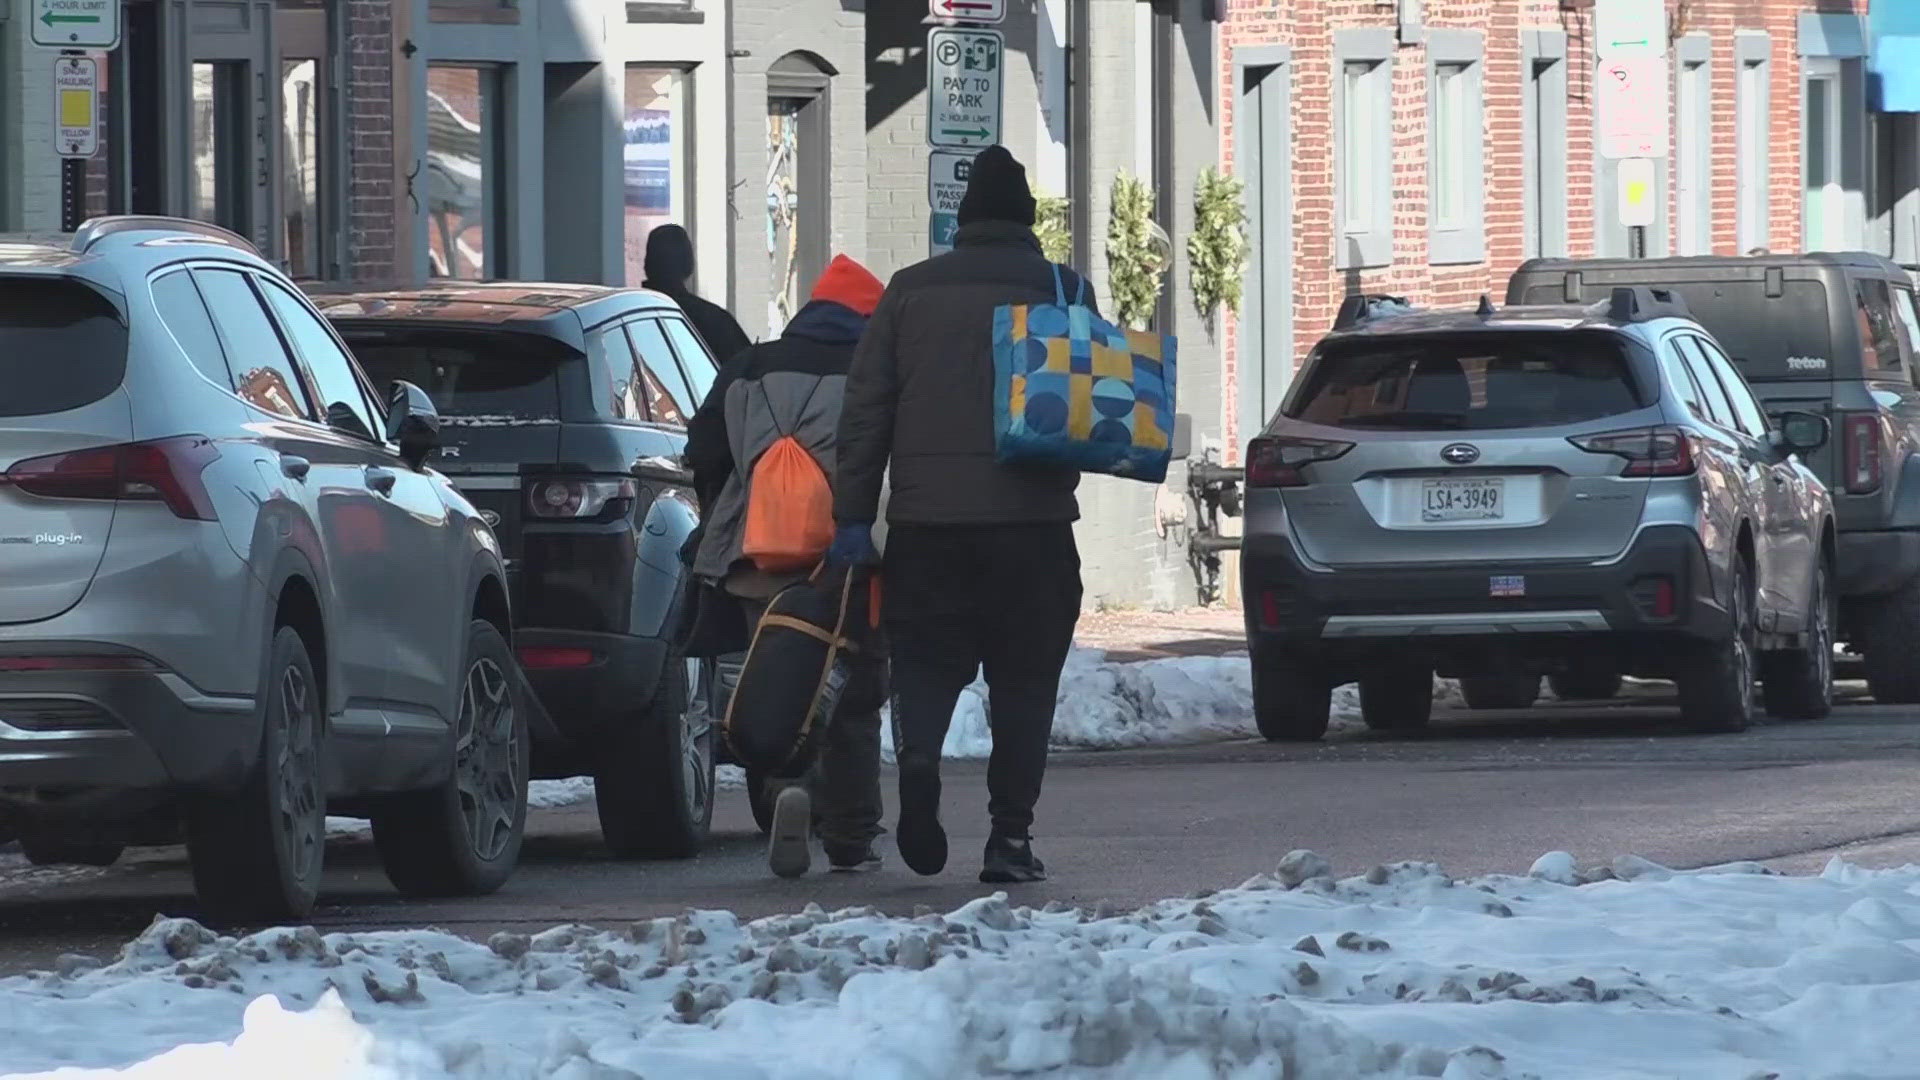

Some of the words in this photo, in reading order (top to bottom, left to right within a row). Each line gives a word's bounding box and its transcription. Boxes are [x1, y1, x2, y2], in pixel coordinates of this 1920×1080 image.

[51, 0, 79, 10] HOUR
[82, 1, 107, 10] LIMIT
[63, 67, 87, 75] SNOW
[57, 77, 93, 87] HAULING
[943, 76, 968, 91] PAY
[974, 78, 990, 93] TO
[948, 93, 983, 108] PARK
[949, 114, 969, 122] HOUR
[972, 115, 991, 123] LIMIT
[61, 129, 91, 137] YELLOW
[1427, 489, 1454, 510] LSA
[1463, 488, 1498, 510] 3949
[35, 532, 83, 546] plug-in
